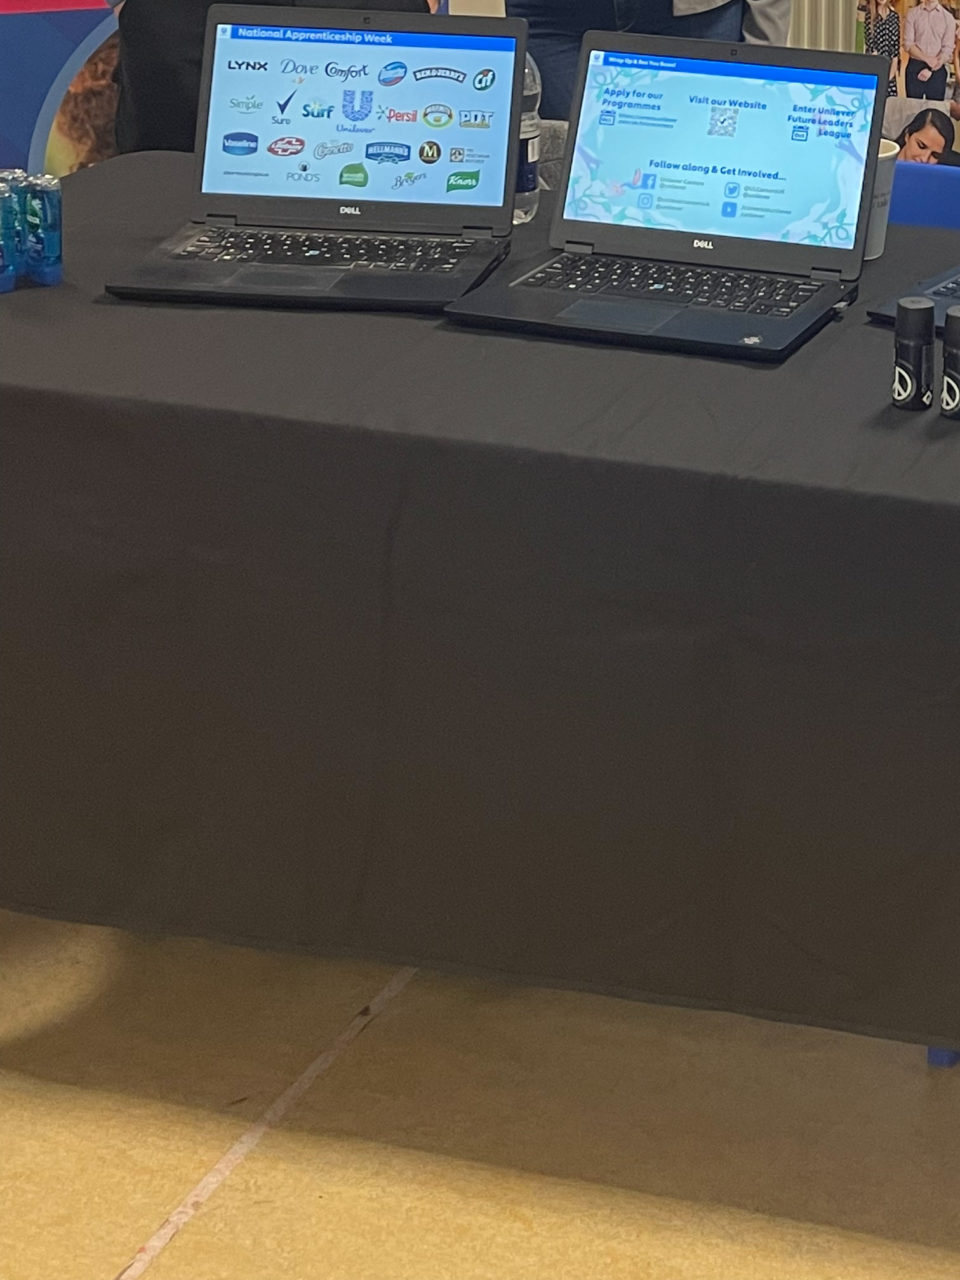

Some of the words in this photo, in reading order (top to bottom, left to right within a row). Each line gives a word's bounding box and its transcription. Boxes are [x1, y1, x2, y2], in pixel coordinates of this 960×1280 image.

[238, 27, 284, 39] National
[285, 29, 362, 45] Apprenticeship
[364, 33, 393, 44] Week
[228, 60, 268, 72] LYNX
[280, 58, 319, 75] Dove
[325, 61, 370, 83] Comfort
[604, 87, 631, 98] Apply
[632, 89, 646, 99] for
[229, 96, 264, 111] Simple
[602, 98, 661, 111] Programmes
[689, 95, 709, 105] Visit
[711, 99, 727, 107] our
[728, 100, 767, 111] Website
[302, 103, 335, 120] Surf
[387, 108, 418, 122] Persil
[792, 104, 816, 114] Enter
[818, 108, 855, 118] Unilever
[787, 115, 816, 125] Future
[818, 119, 853, 129] Leaders
[818, 129, 852, 140] League
[649, 159, 681, 170] Follow
[681, 163, 710, 175] along
[711, 165, 718, 173] &
[720, 166, 736, 176] Get
[340, 206, 361, 215] DELL
[693, 239, 714, 249] DELL
